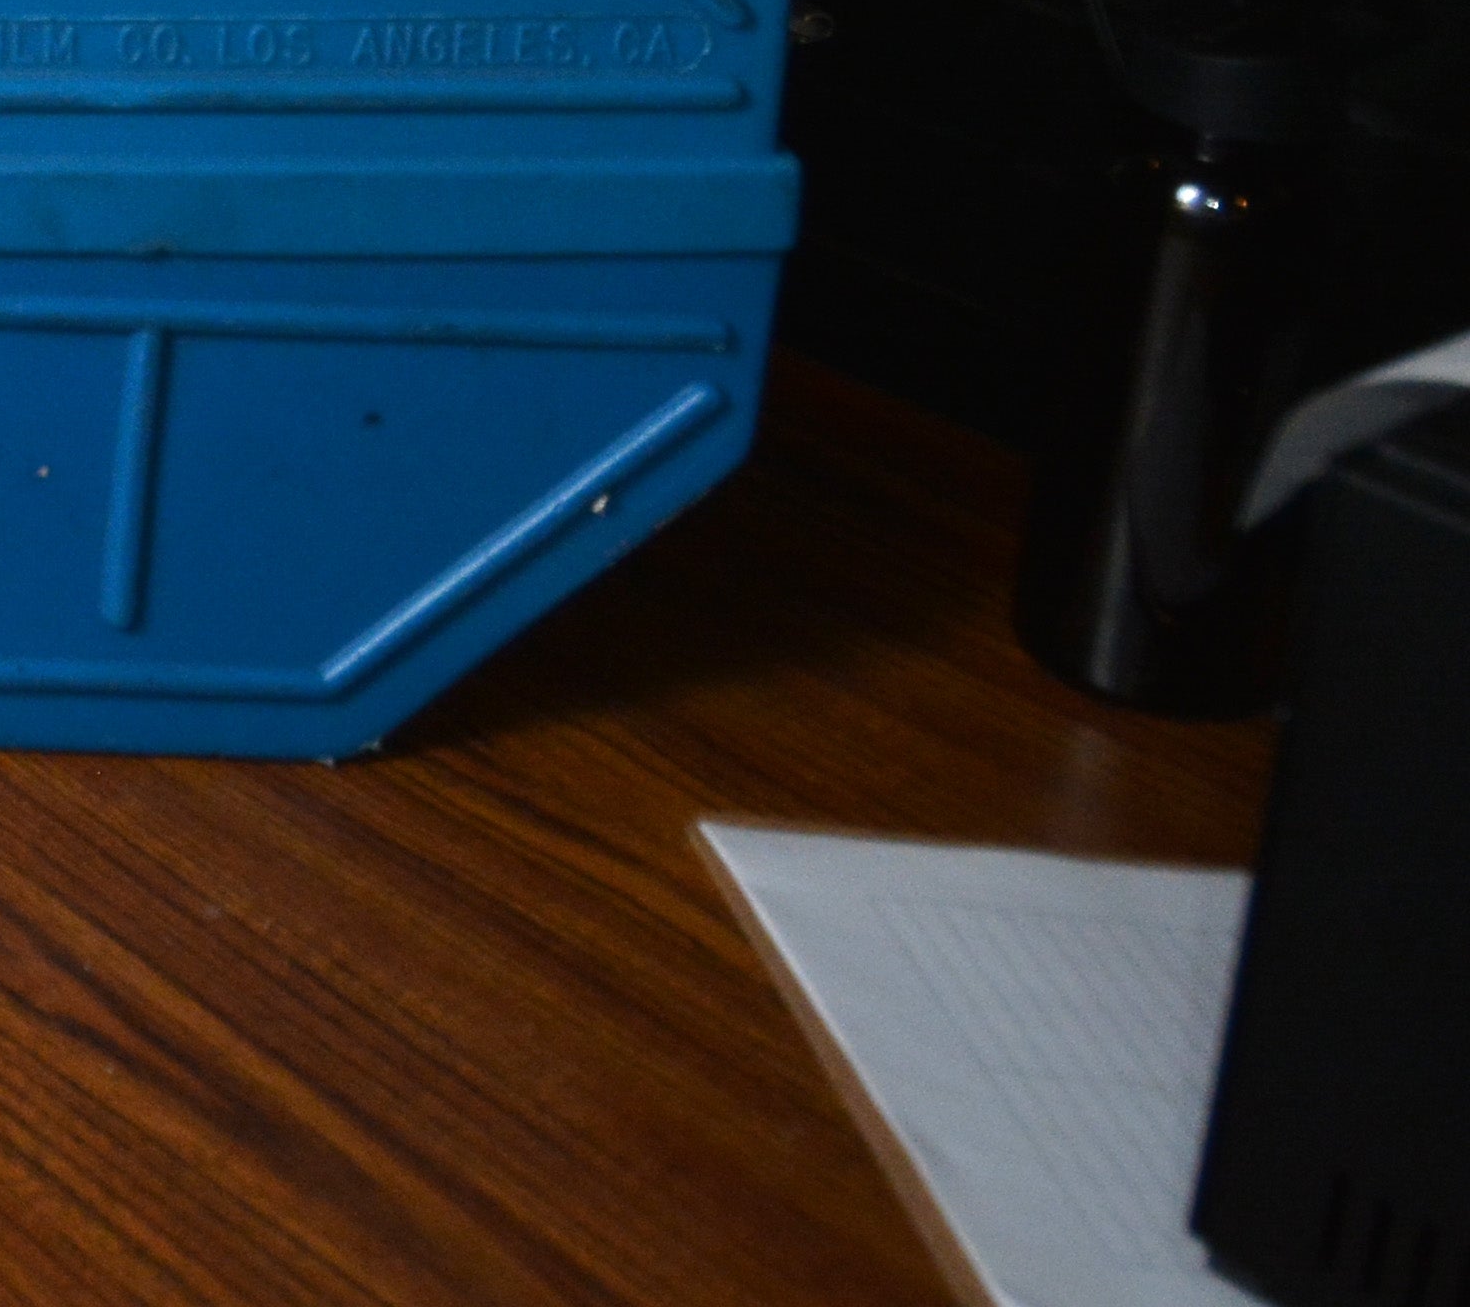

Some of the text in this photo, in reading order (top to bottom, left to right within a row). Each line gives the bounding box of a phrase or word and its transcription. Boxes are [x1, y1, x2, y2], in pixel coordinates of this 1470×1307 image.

[116, 22, 190, 67] CO.
[216, 23, 312, 68] LOS
[615, 24, 676, 68] CA
